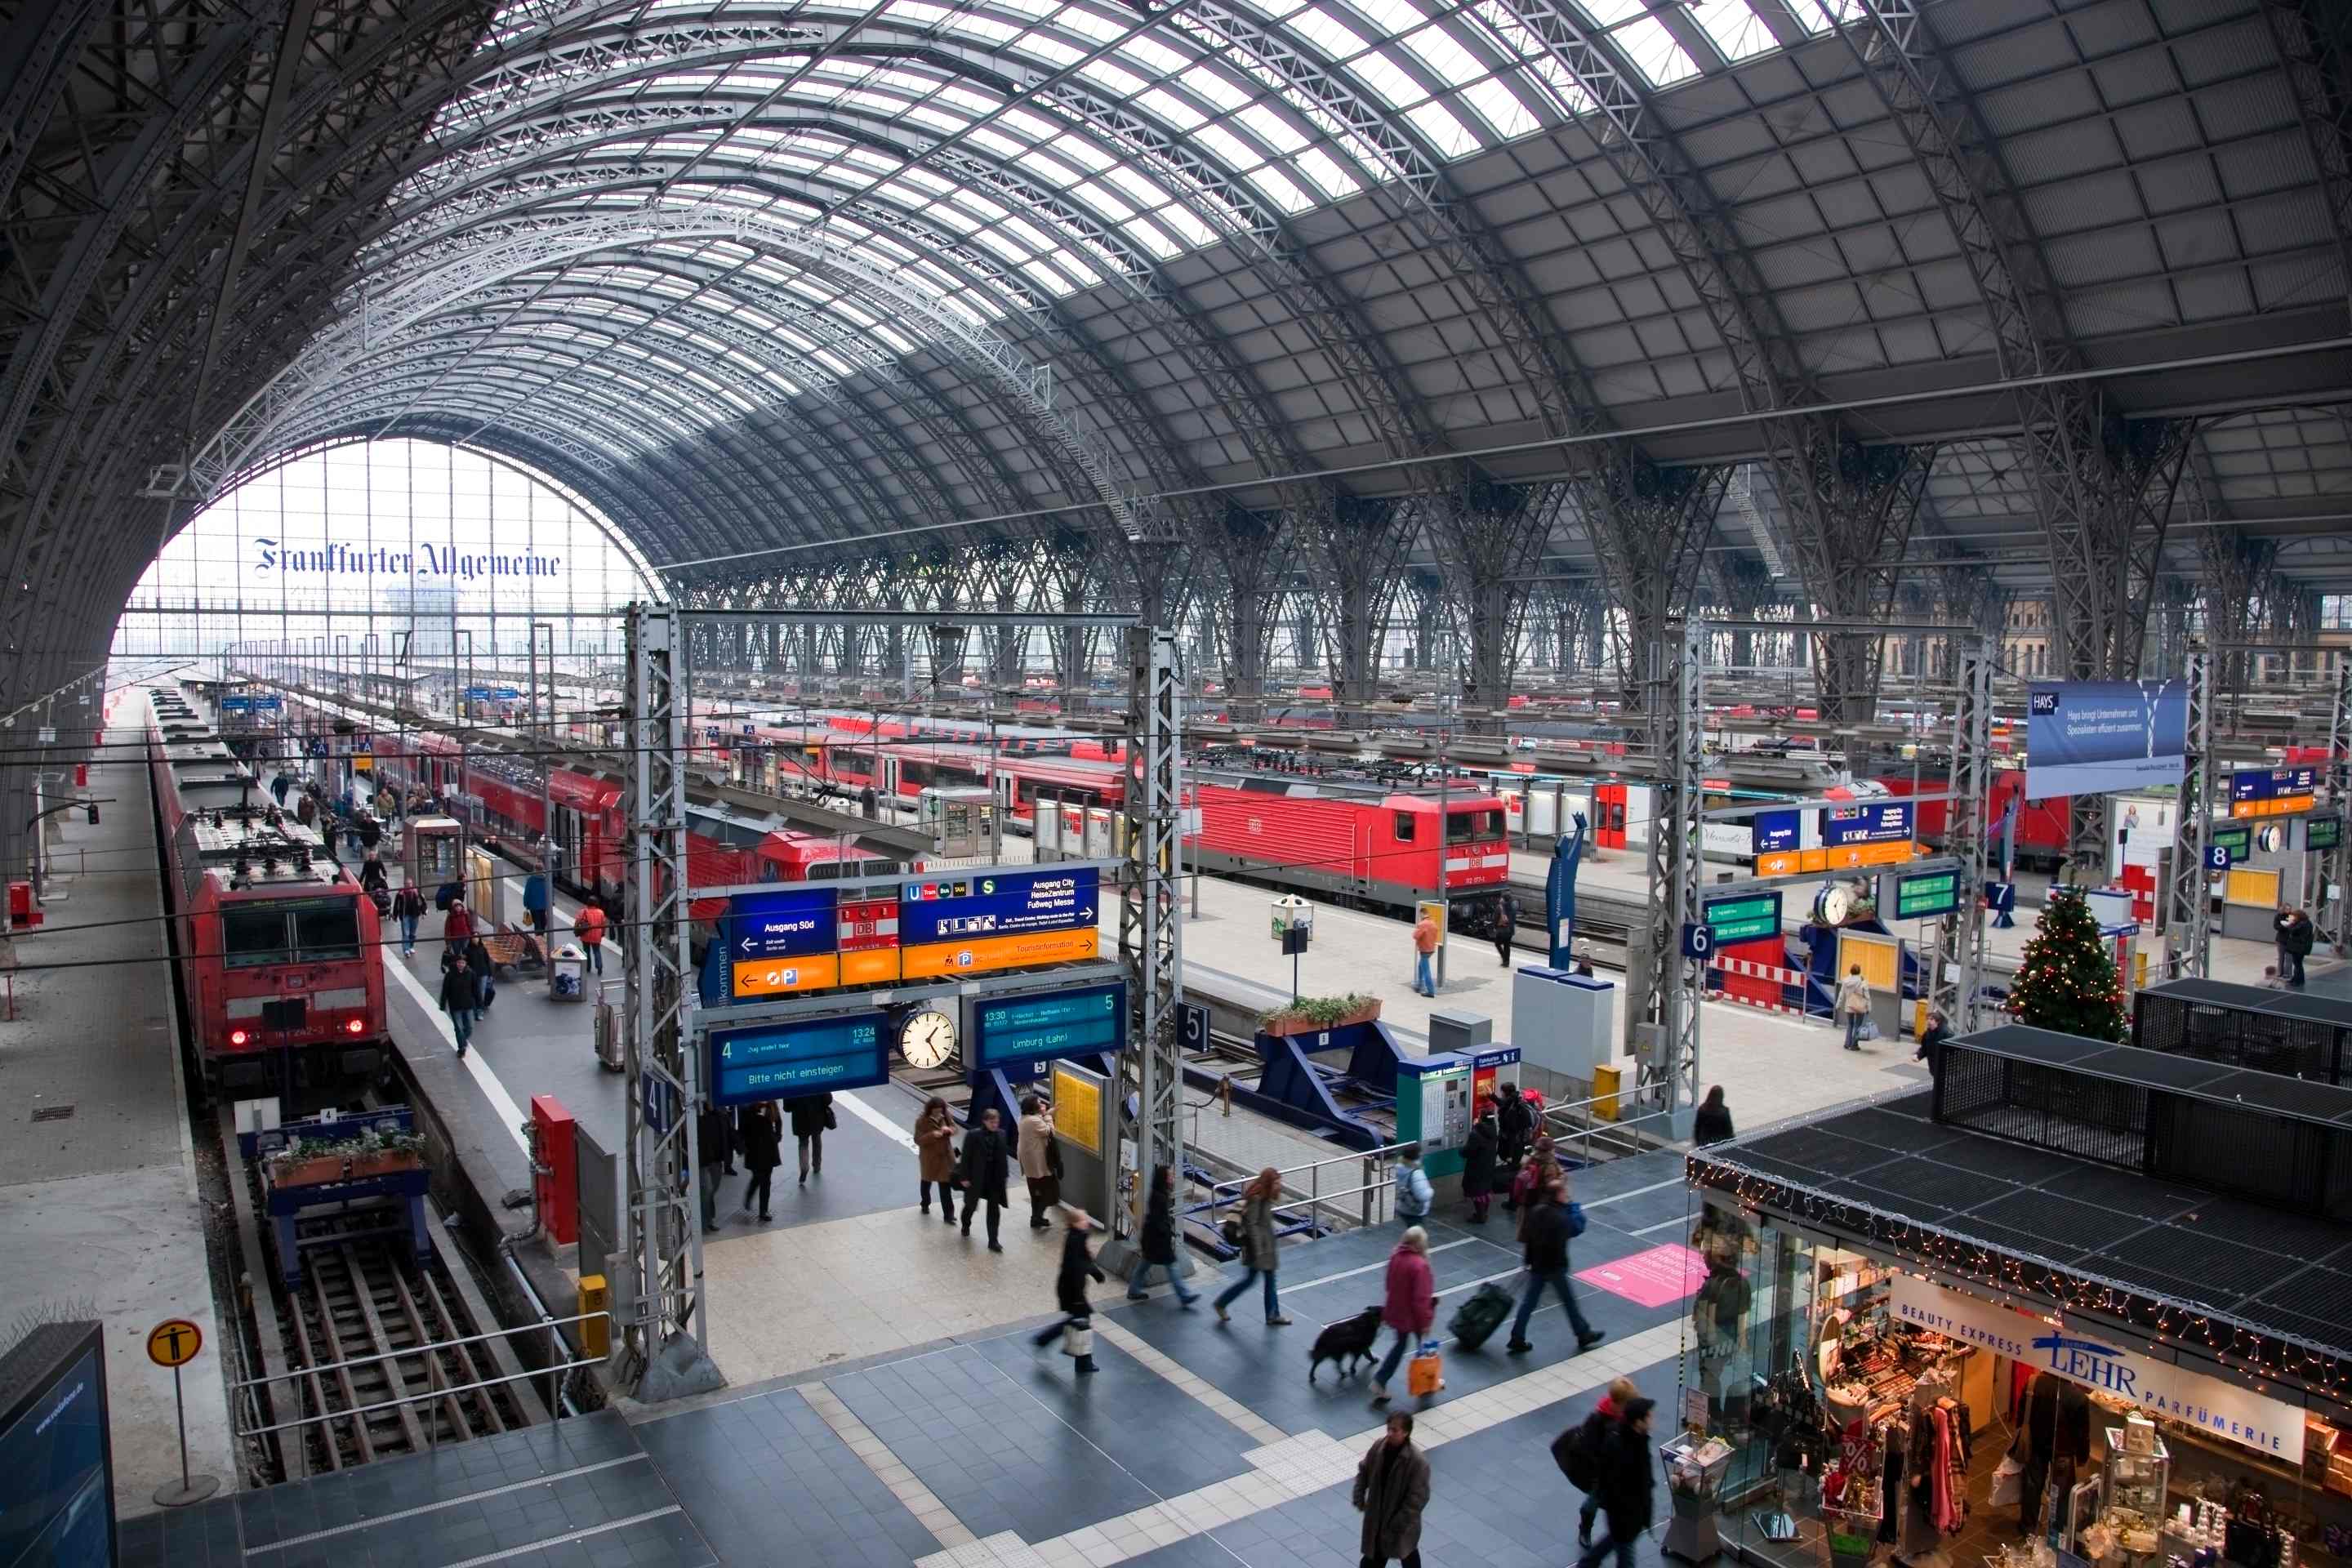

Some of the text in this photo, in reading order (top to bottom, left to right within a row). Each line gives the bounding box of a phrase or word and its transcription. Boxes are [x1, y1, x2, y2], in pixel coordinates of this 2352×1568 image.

[255, 538, 560, 581] Frankfurter Allgemeine
[2034, 695, 2053, 708] HAYS
[318, 744, 326, 754] A
[2214, 847, 2226, 866] 8
[983, 880, 994, 894] S
[1033, 879, 1075, 890] Ausgang City
[910, 887, 920, 900] U
[1031, 889, 1075, 898] ReiseZentrum
[1995, 884, 2009, 904] 7
[1027, 898, 1075, 910] Fußweg Messe
[765, 920, 814, 933] Ausgang Süd
[858, 923, 873, 934] DB
[1693, 926, 1708, 951] 6
[1016, 940, 1074, 954] Touristinformation
[1105, 995, 1113, 1009] 5
[985, 1011, 1005, 1022] 13:30
[1186, 1009, 1200, 1040] 5
[853, 1027, 875, 1038] 13:24
[1013, 1031, 1068, 1050] Limburg (Lahn)
[722, 1041, 733, 1059] 4
[749, 1064, 844, 1085] Bitte nicht einsteigen
[1902, 1304, 2022, 1356] BEAUTY EXPRESS
[2050, 1330, 2137, 1398] LEHR
[2145, 1391, 2280, 1450] PARFÜMERIE
